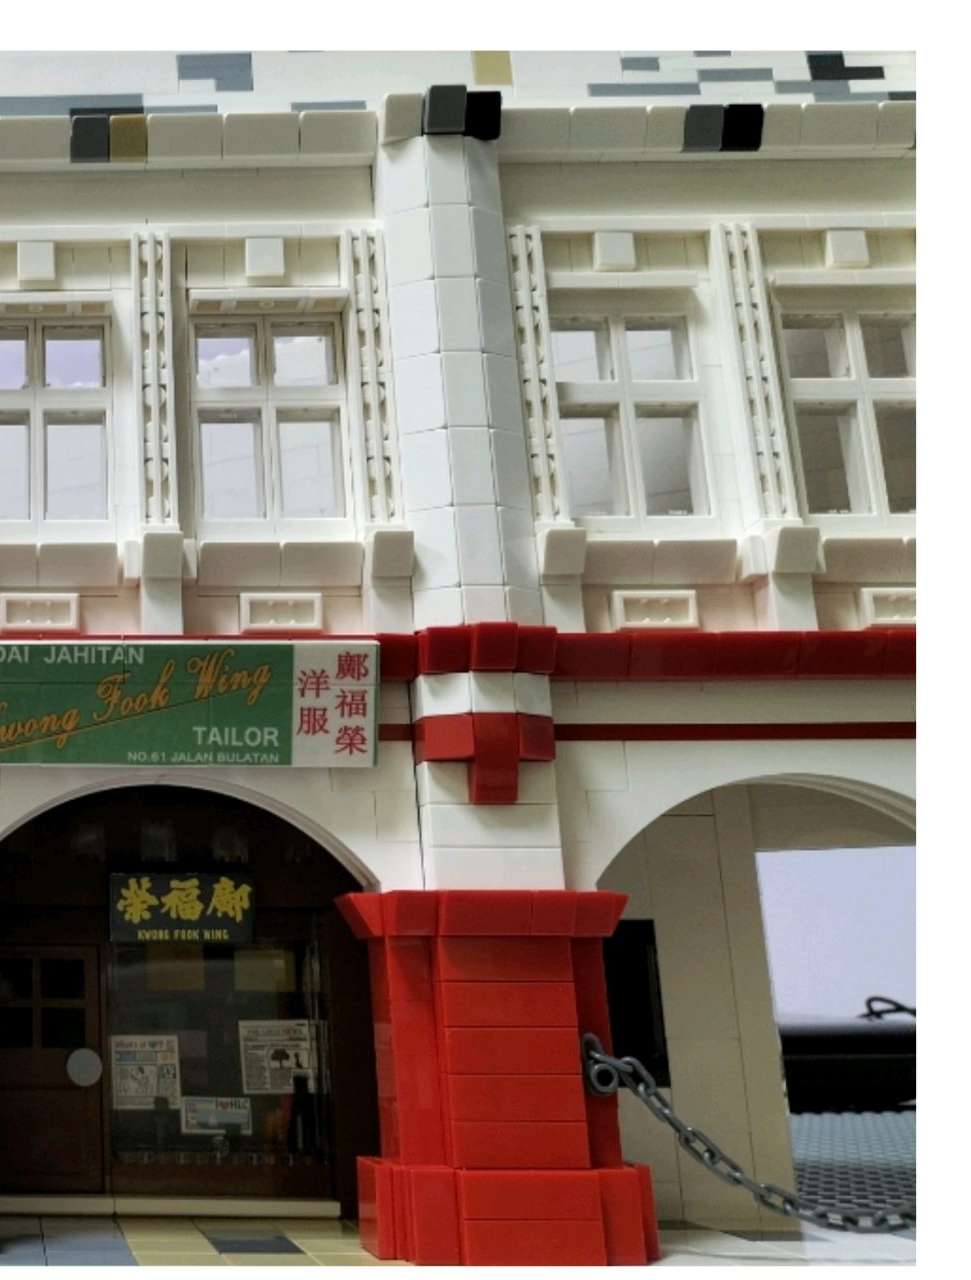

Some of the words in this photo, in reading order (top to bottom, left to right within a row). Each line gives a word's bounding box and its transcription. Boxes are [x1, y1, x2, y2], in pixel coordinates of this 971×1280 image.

[44, 646, 145, 664] JAHITAN
[93, 659, 175, 722] Fook
[187, 648, 271, 706] Wing
[297, 669, 330, 736] 洋服
[193, 727, 279, 747] TAILOR
[171, 752, 212, 763] JALAN
